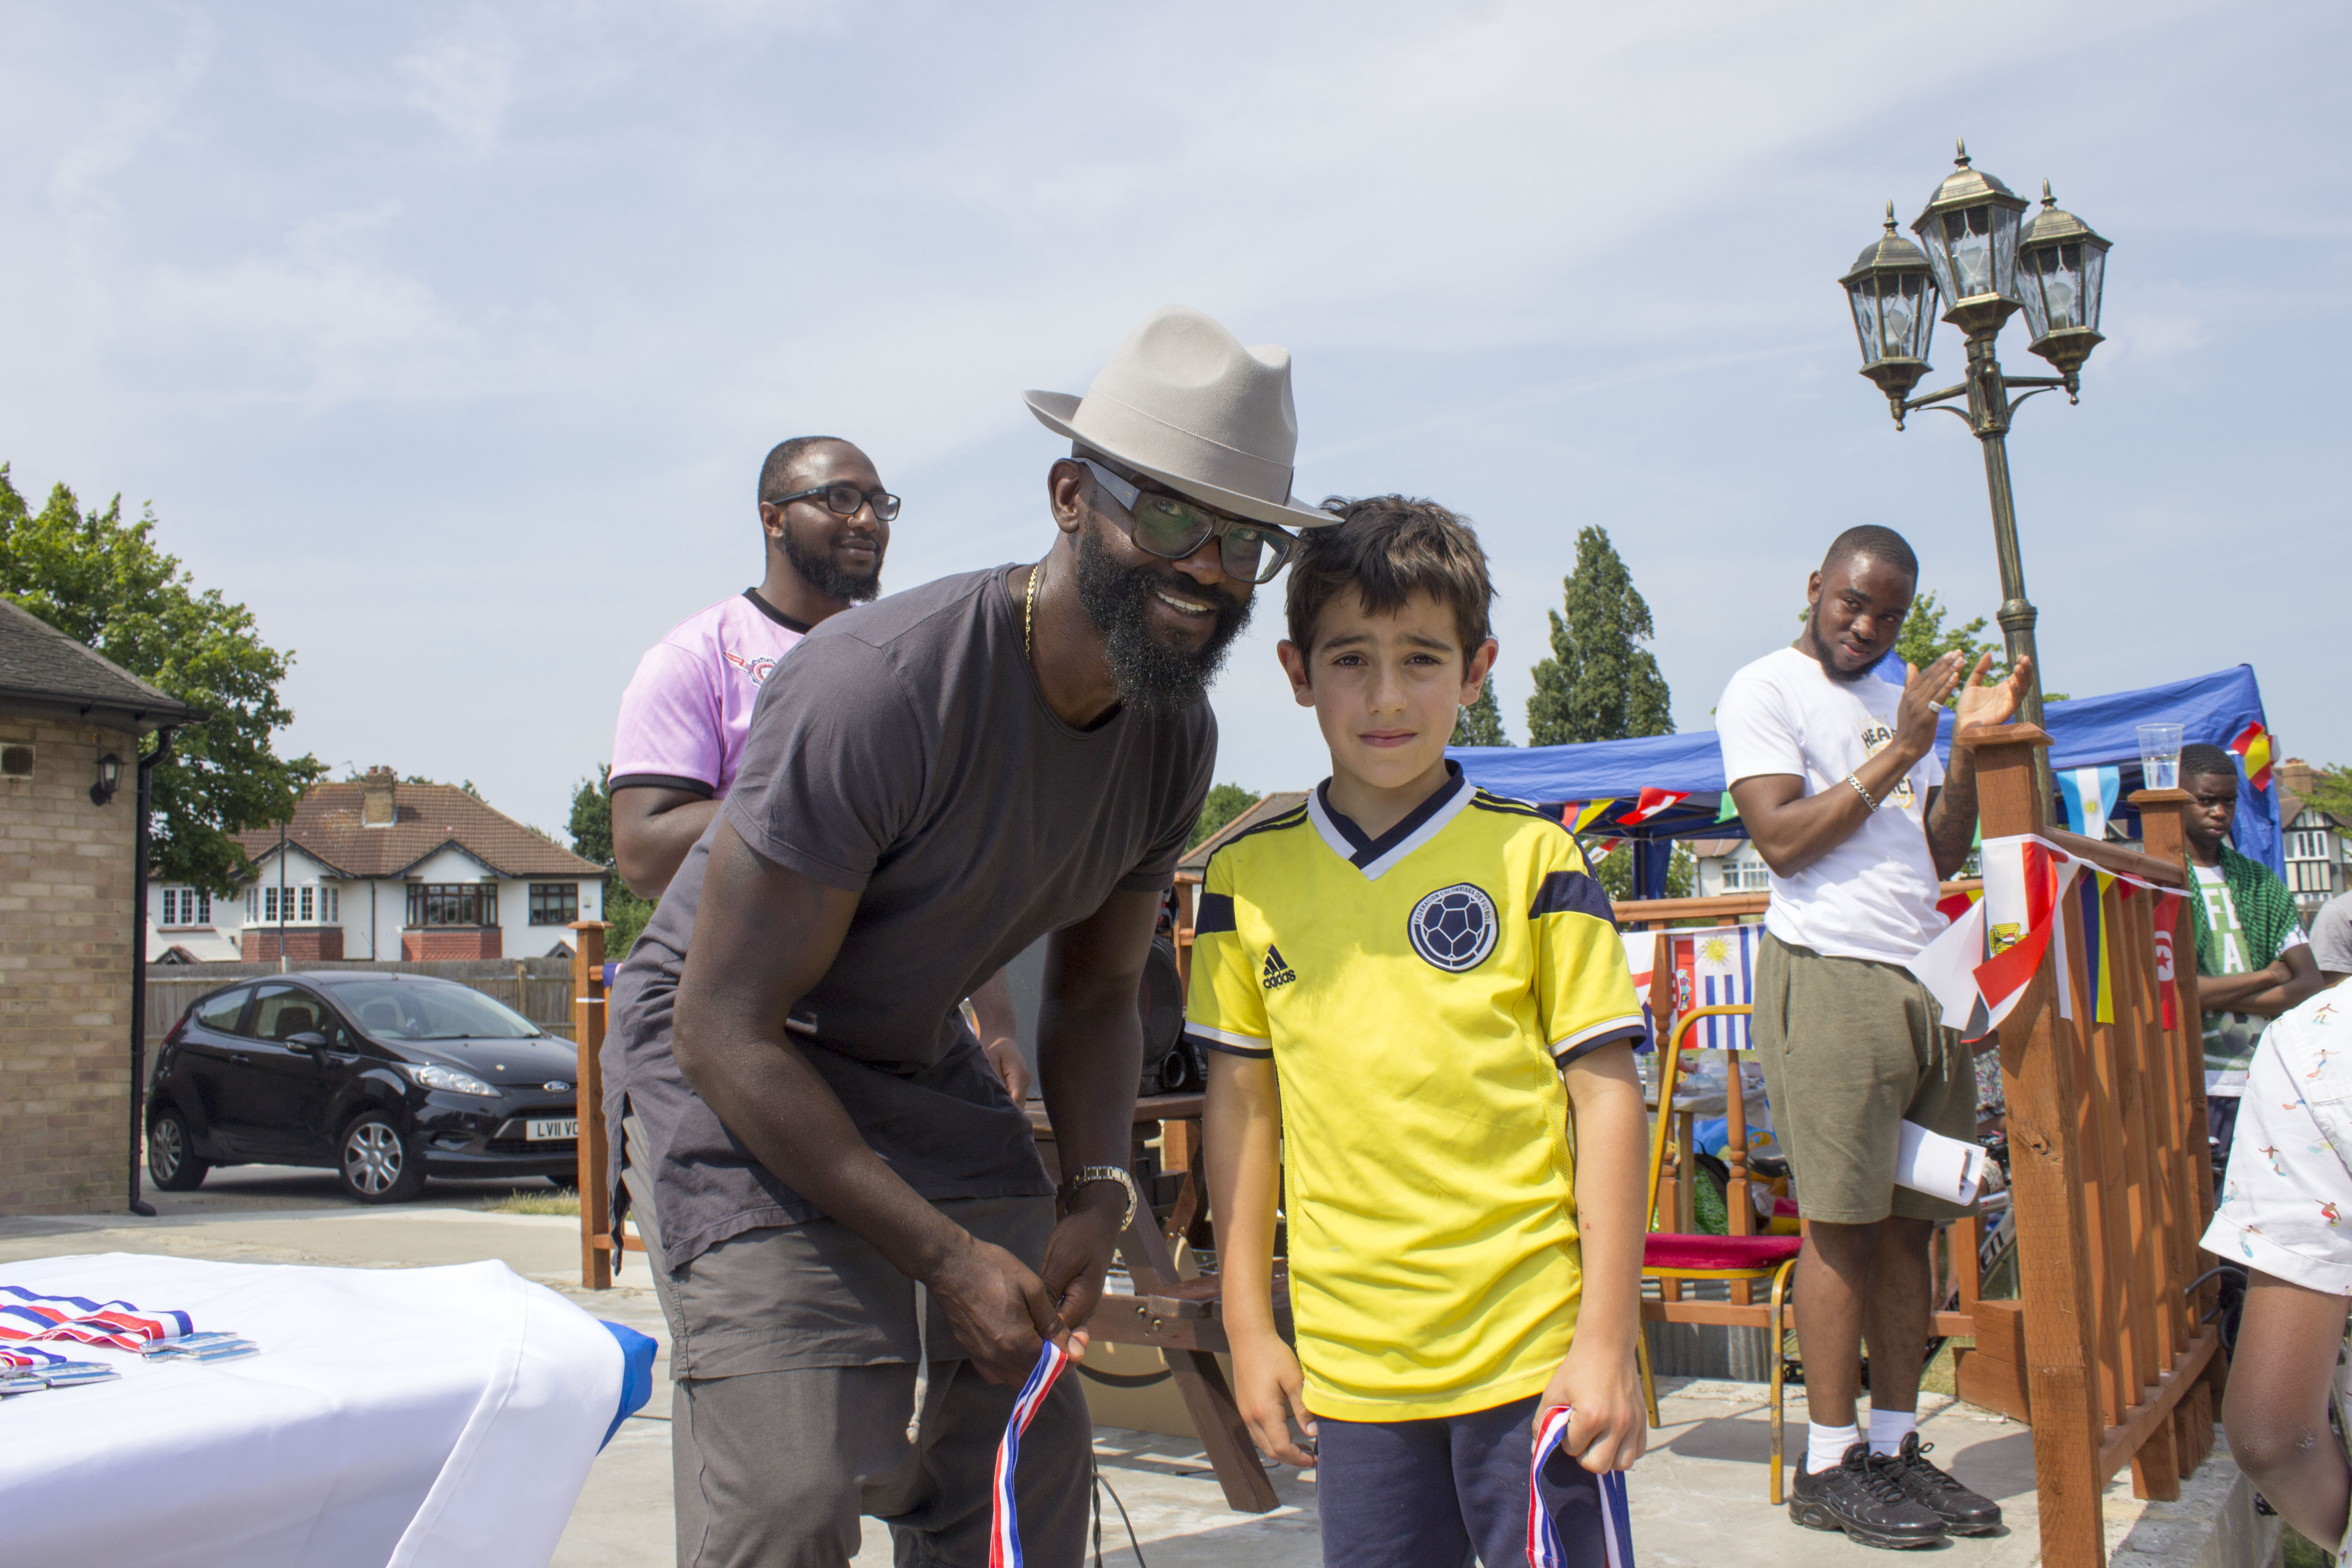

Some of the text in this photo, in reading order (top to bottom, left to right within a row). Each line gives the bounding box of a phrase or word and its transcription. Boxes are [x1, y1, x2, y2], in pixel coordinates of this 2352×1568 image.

[1415, 893, 1440, 923] FEDERACION
[1440, 886, 1475, 896] COLOMBIANA
[1475, 892, 1484, 902] DE
[1263, 970, 1296, 989] adidas
